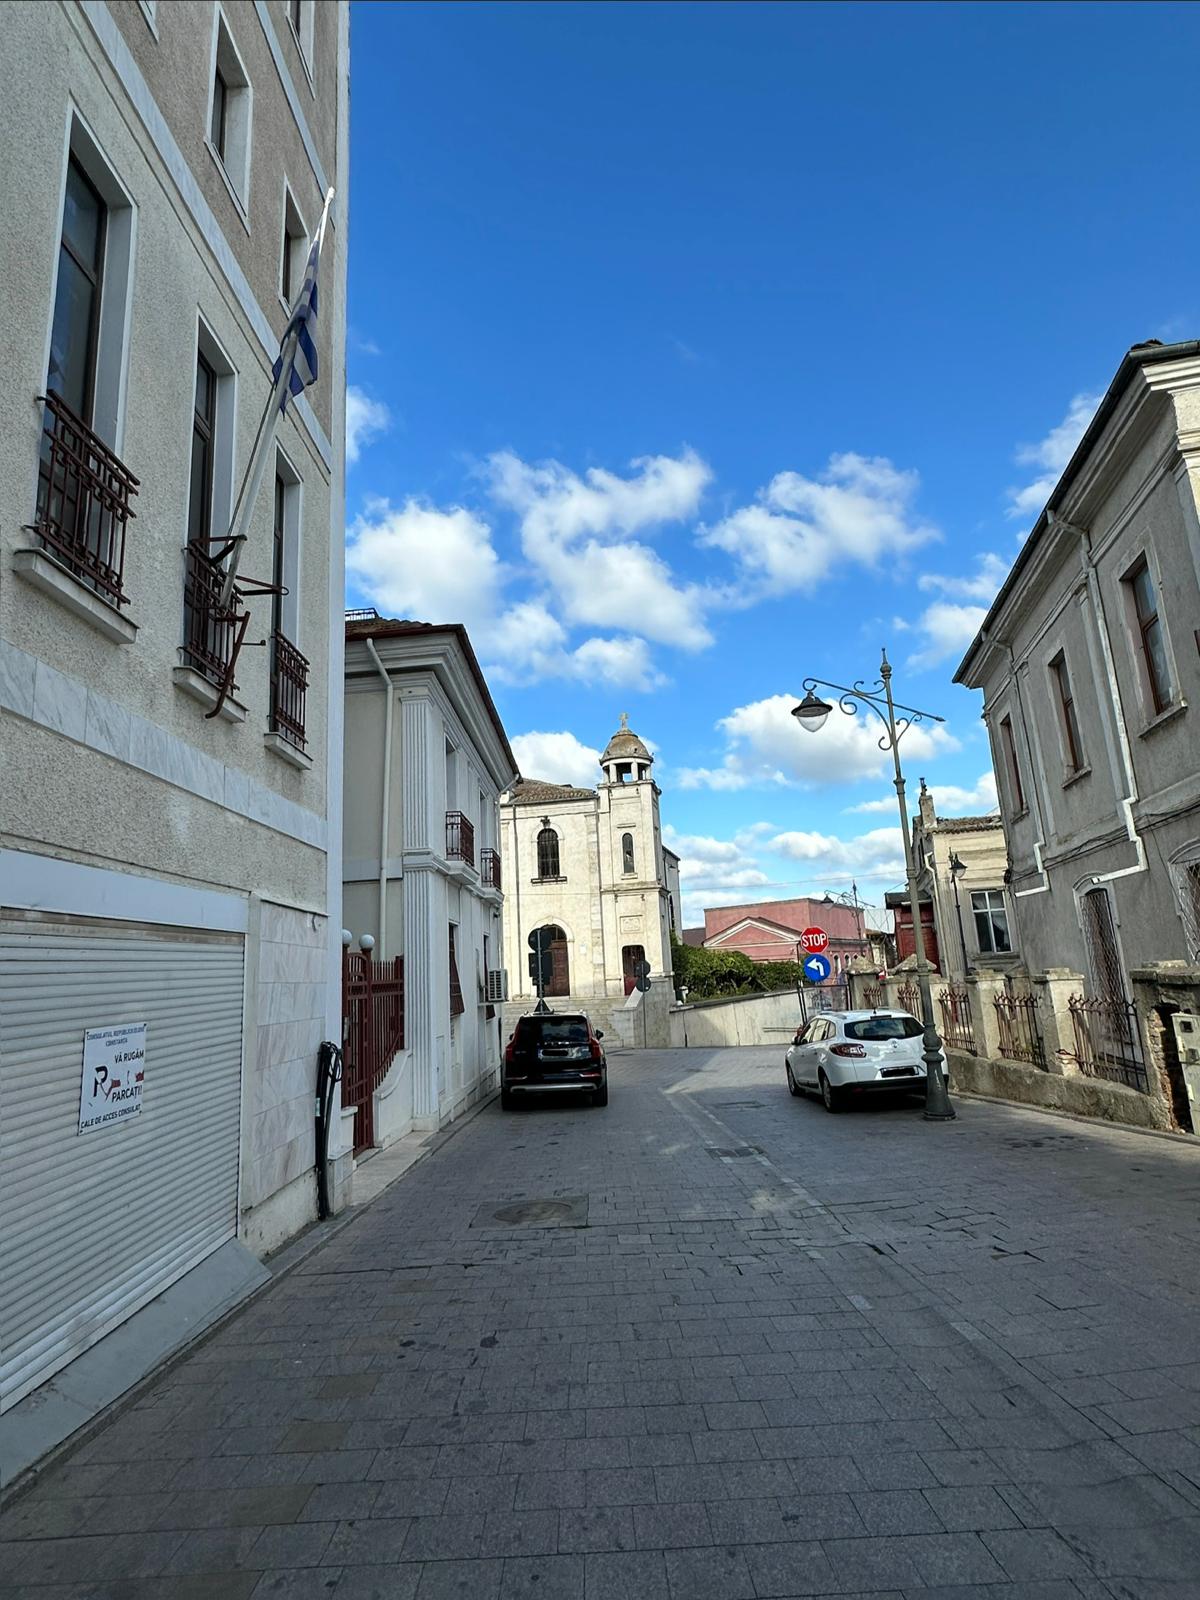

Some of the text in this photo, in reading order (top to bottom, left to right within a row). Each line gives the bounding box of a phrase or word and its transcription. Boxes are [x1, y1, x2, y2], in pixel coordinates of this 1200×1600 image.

[802, 933, 827, 947] STOP
[123, 1048, 144, 1062] RUGĂM
[80, 1103, 141, 1129] CALE DE ACCES CONSULAT
